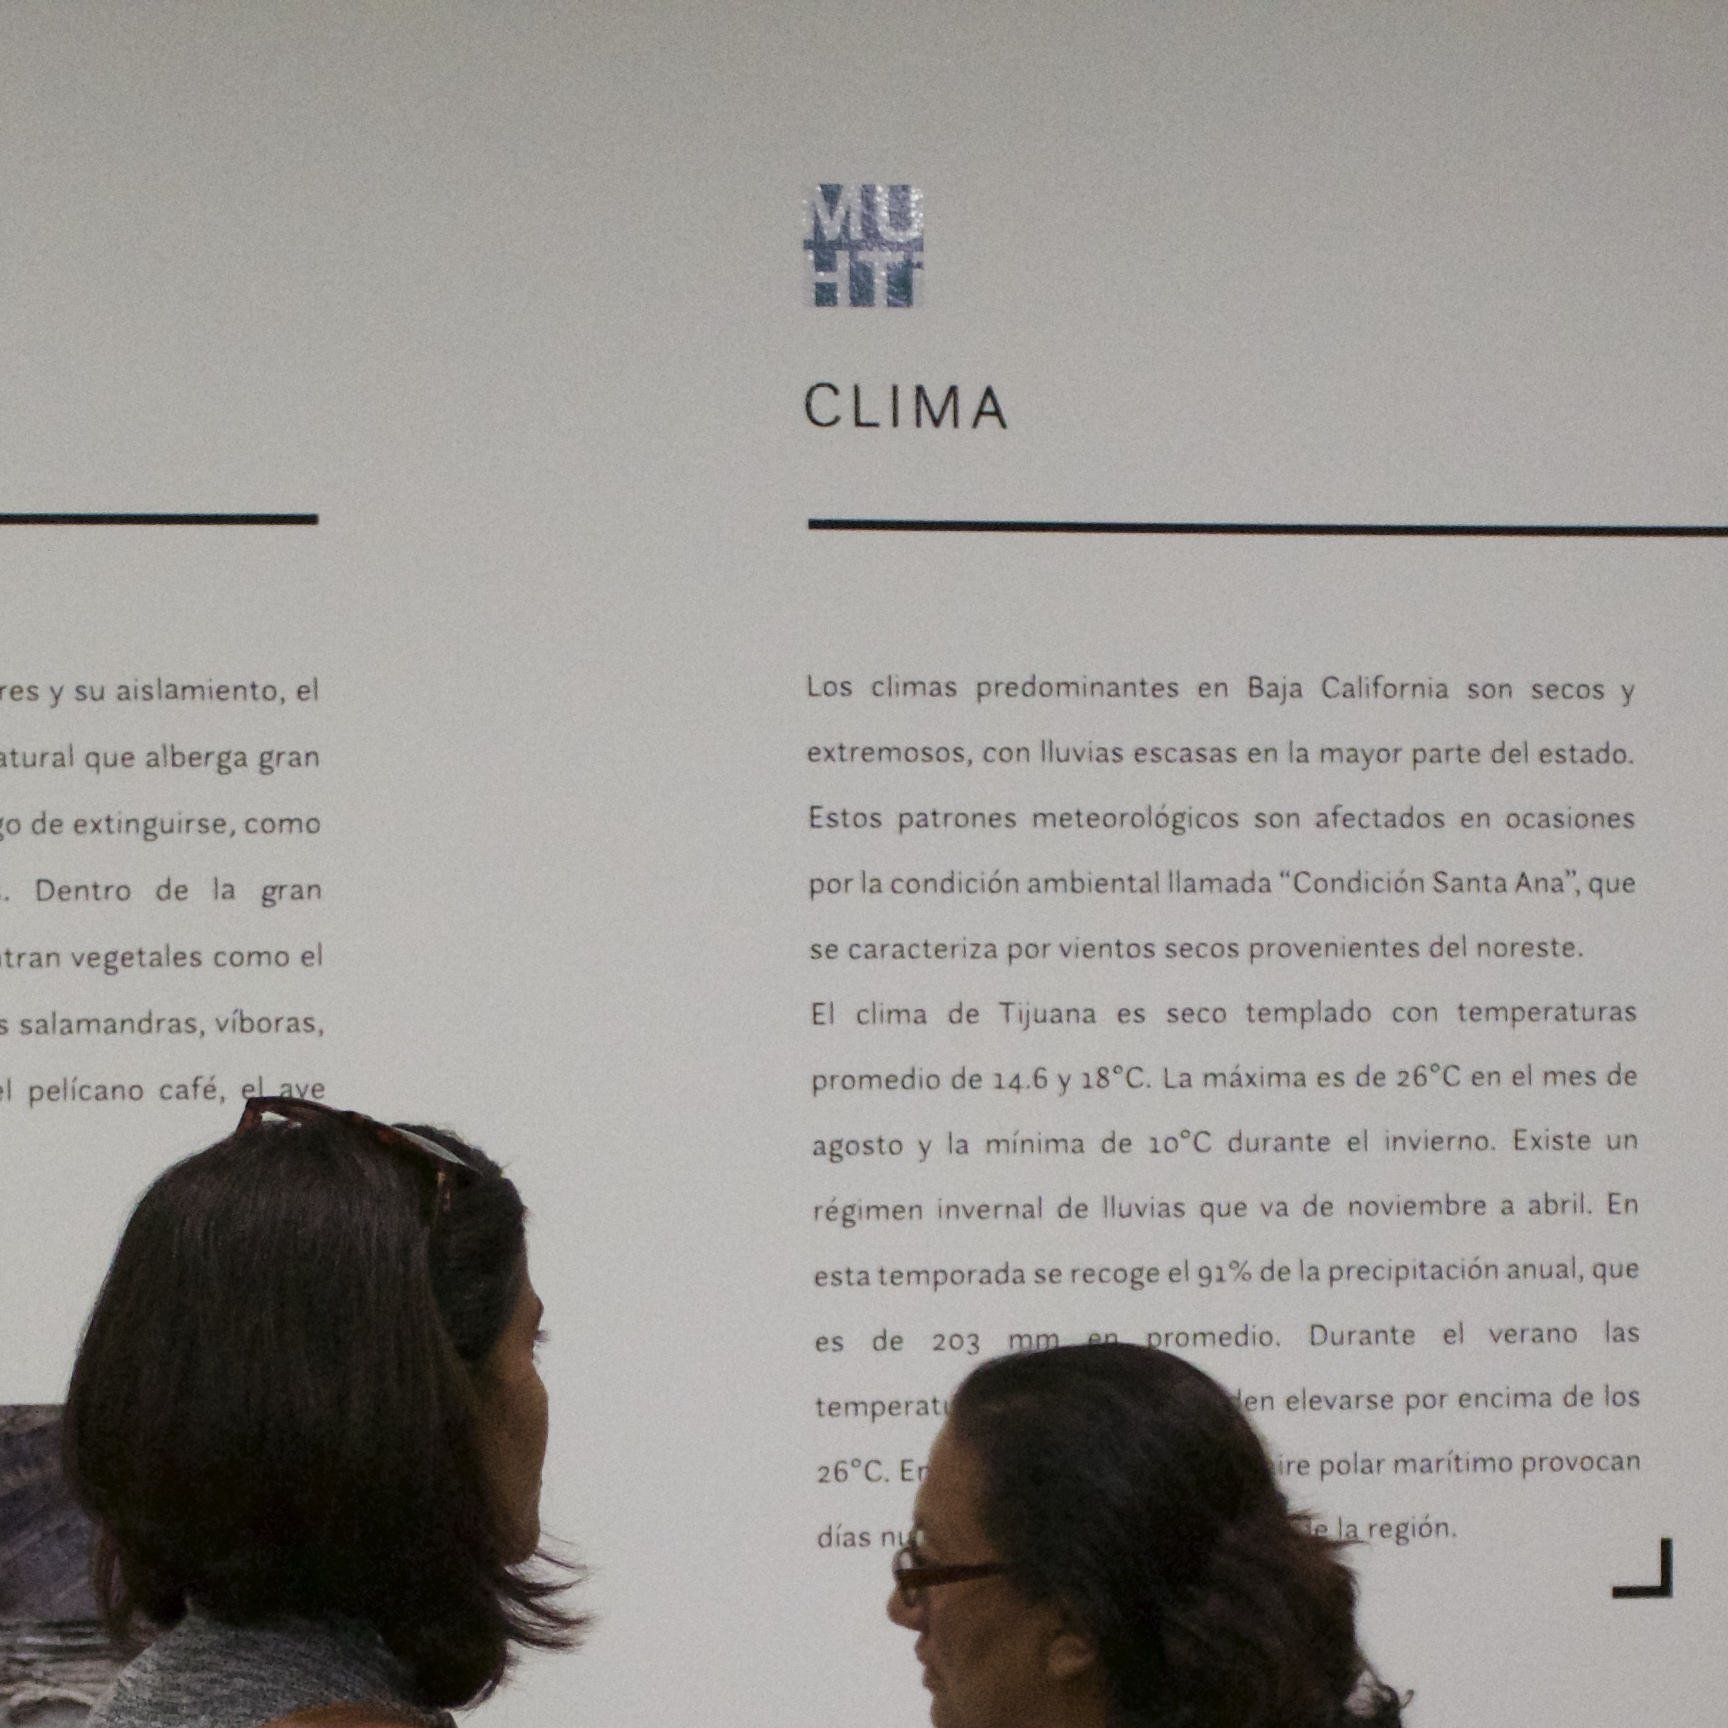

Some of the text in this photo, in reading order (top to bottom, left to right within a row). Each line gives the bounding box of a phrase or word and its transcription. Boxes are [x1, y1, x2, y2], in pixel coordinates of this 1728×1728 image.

[803, 380, 1009, 431] CLIMA
[48, 684, 65, 710] y
[74, 683, 106, 703] su
[115, 676, 287, 706] aislamiento,
[295, 676, 319, 703] el
[806, 672, 1636, 708] Los climas predominantes en Baja California son secos y
[83, 750, 136, 776] que
[144, 742, 249, 777] alberga
[257, 748, 321, 777] gran
[29, 809, 65, 837] de
[71, 813, 237, 843] extinguirse,
[243, 816, 322, 836] como
[808, 803, 1636, 837] Estos patrones meteorológicos son afectados en ocasiones
[70, 942, 204, 977] vegetales
[212, 949, 291, 969] como
[299, 941, 323, 969] el
[809, 933, 1584, 967] se caracteriza por vientos secos provenientes del noreste.
[18, 1008, 206, 1039] salamandras,
[214, 1007, 325, 1038] víboras,
[810, 998, 1638, 1032] El clima de Tijuana es seco templado con temperaturas
[813, 1190, 1639, 1230] régimen invernal de lluvias que va de noviembre a abril. En
